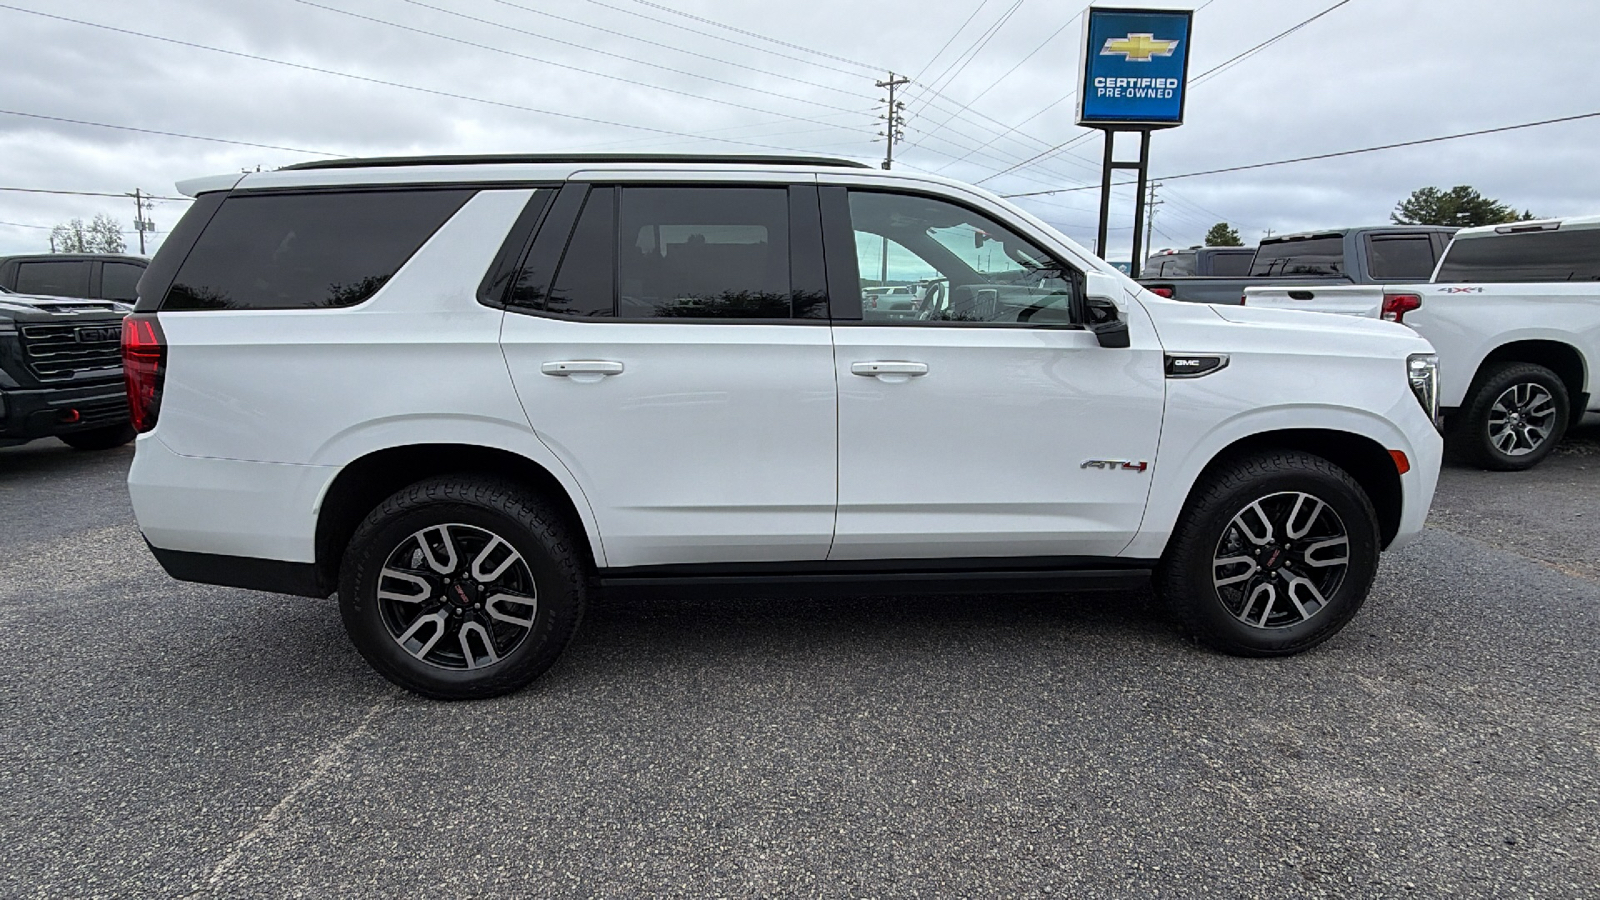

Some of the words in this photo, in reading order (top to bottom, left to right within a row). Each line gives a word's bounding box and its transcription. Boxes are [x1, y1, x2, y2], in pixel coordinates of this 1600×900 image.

[1094, 77, 1178, 88] CERTIFIED
[1097, 88, 1173, 98] PRE-OWNED
[1080, 458, 1148, 473] AT4
